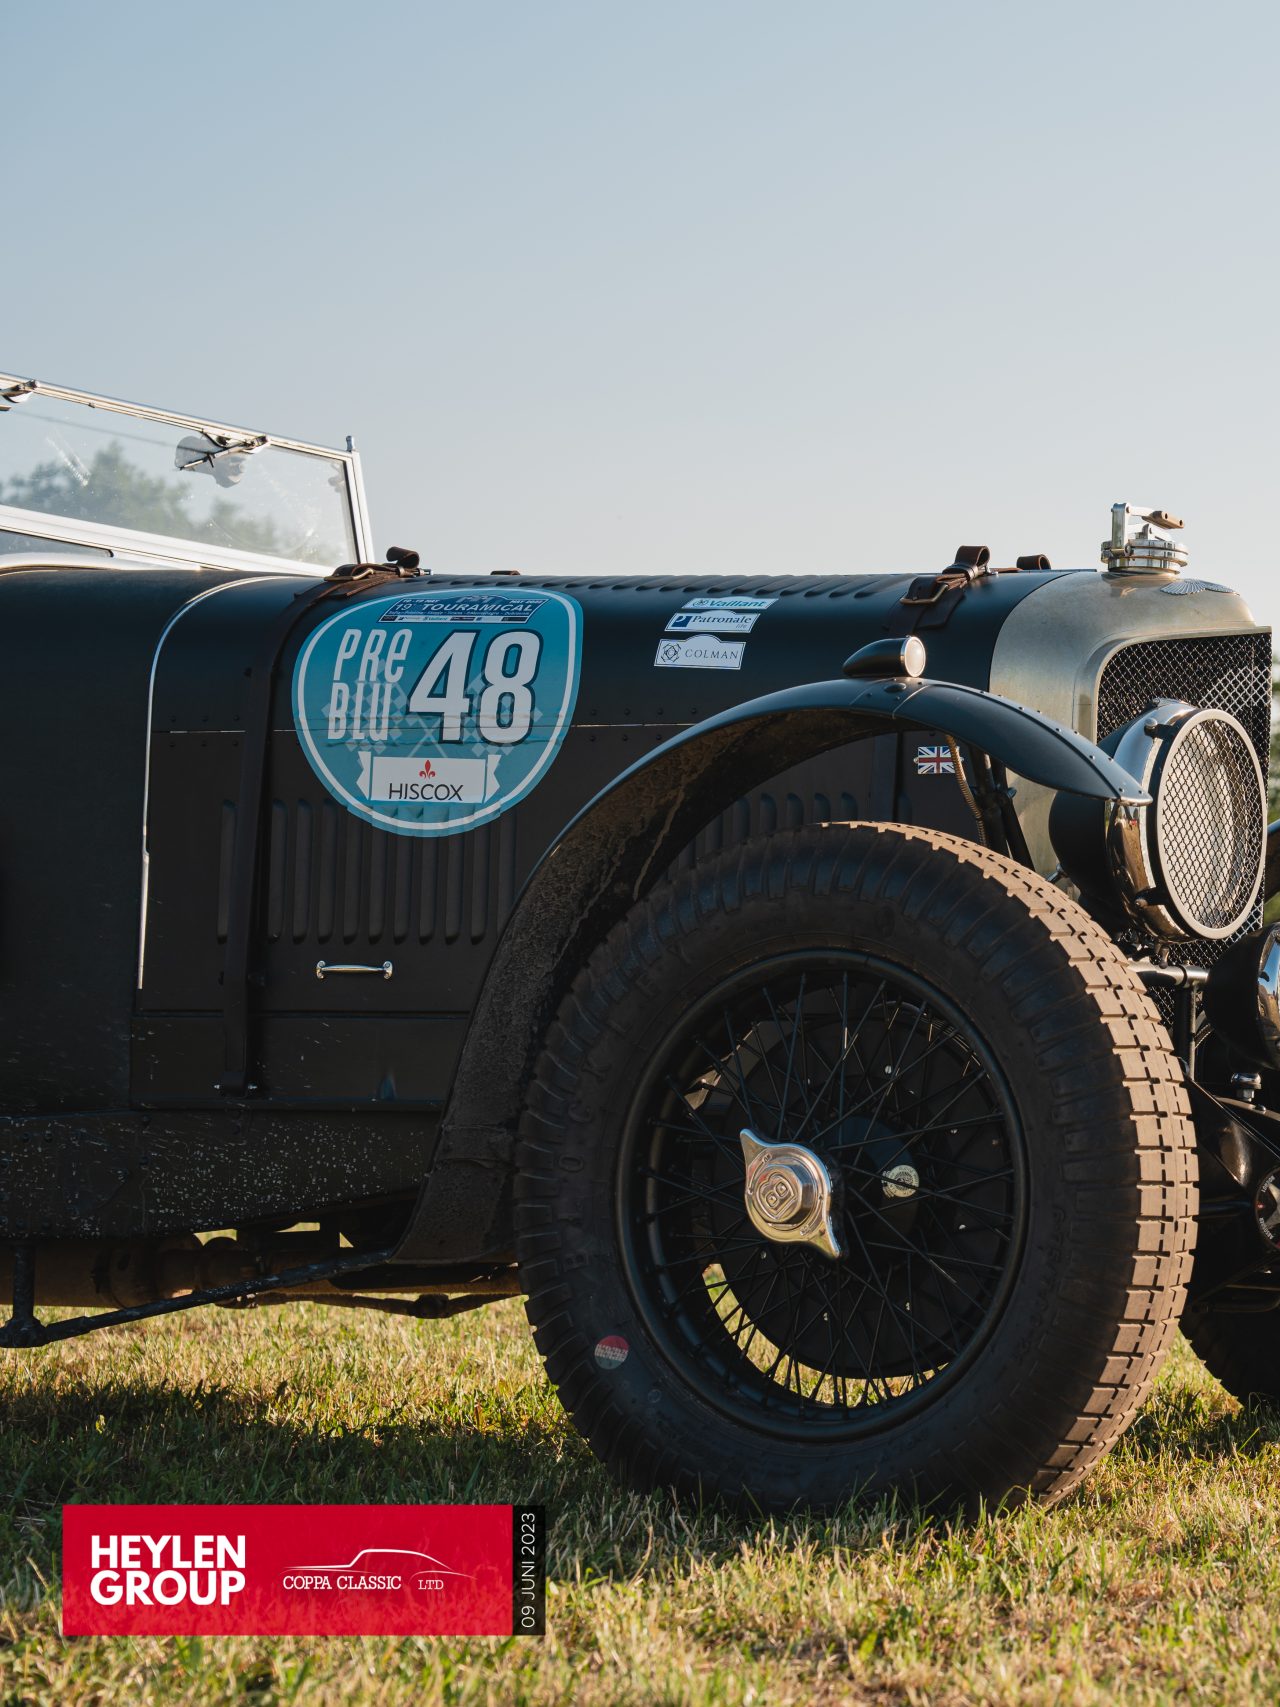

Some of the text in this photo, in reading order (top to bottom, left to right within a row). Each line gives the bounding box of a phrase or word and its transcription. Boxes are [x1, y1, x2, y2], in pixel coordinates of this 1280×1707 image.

[422, 603, 533, 612] TOURAMICAL
[692, 615, 751, 624] Patronale
[685, 648, 739, 660] COLMAN
[407, 630, 543, 745] 48
[388, 782, 464, 802] HISCOX
